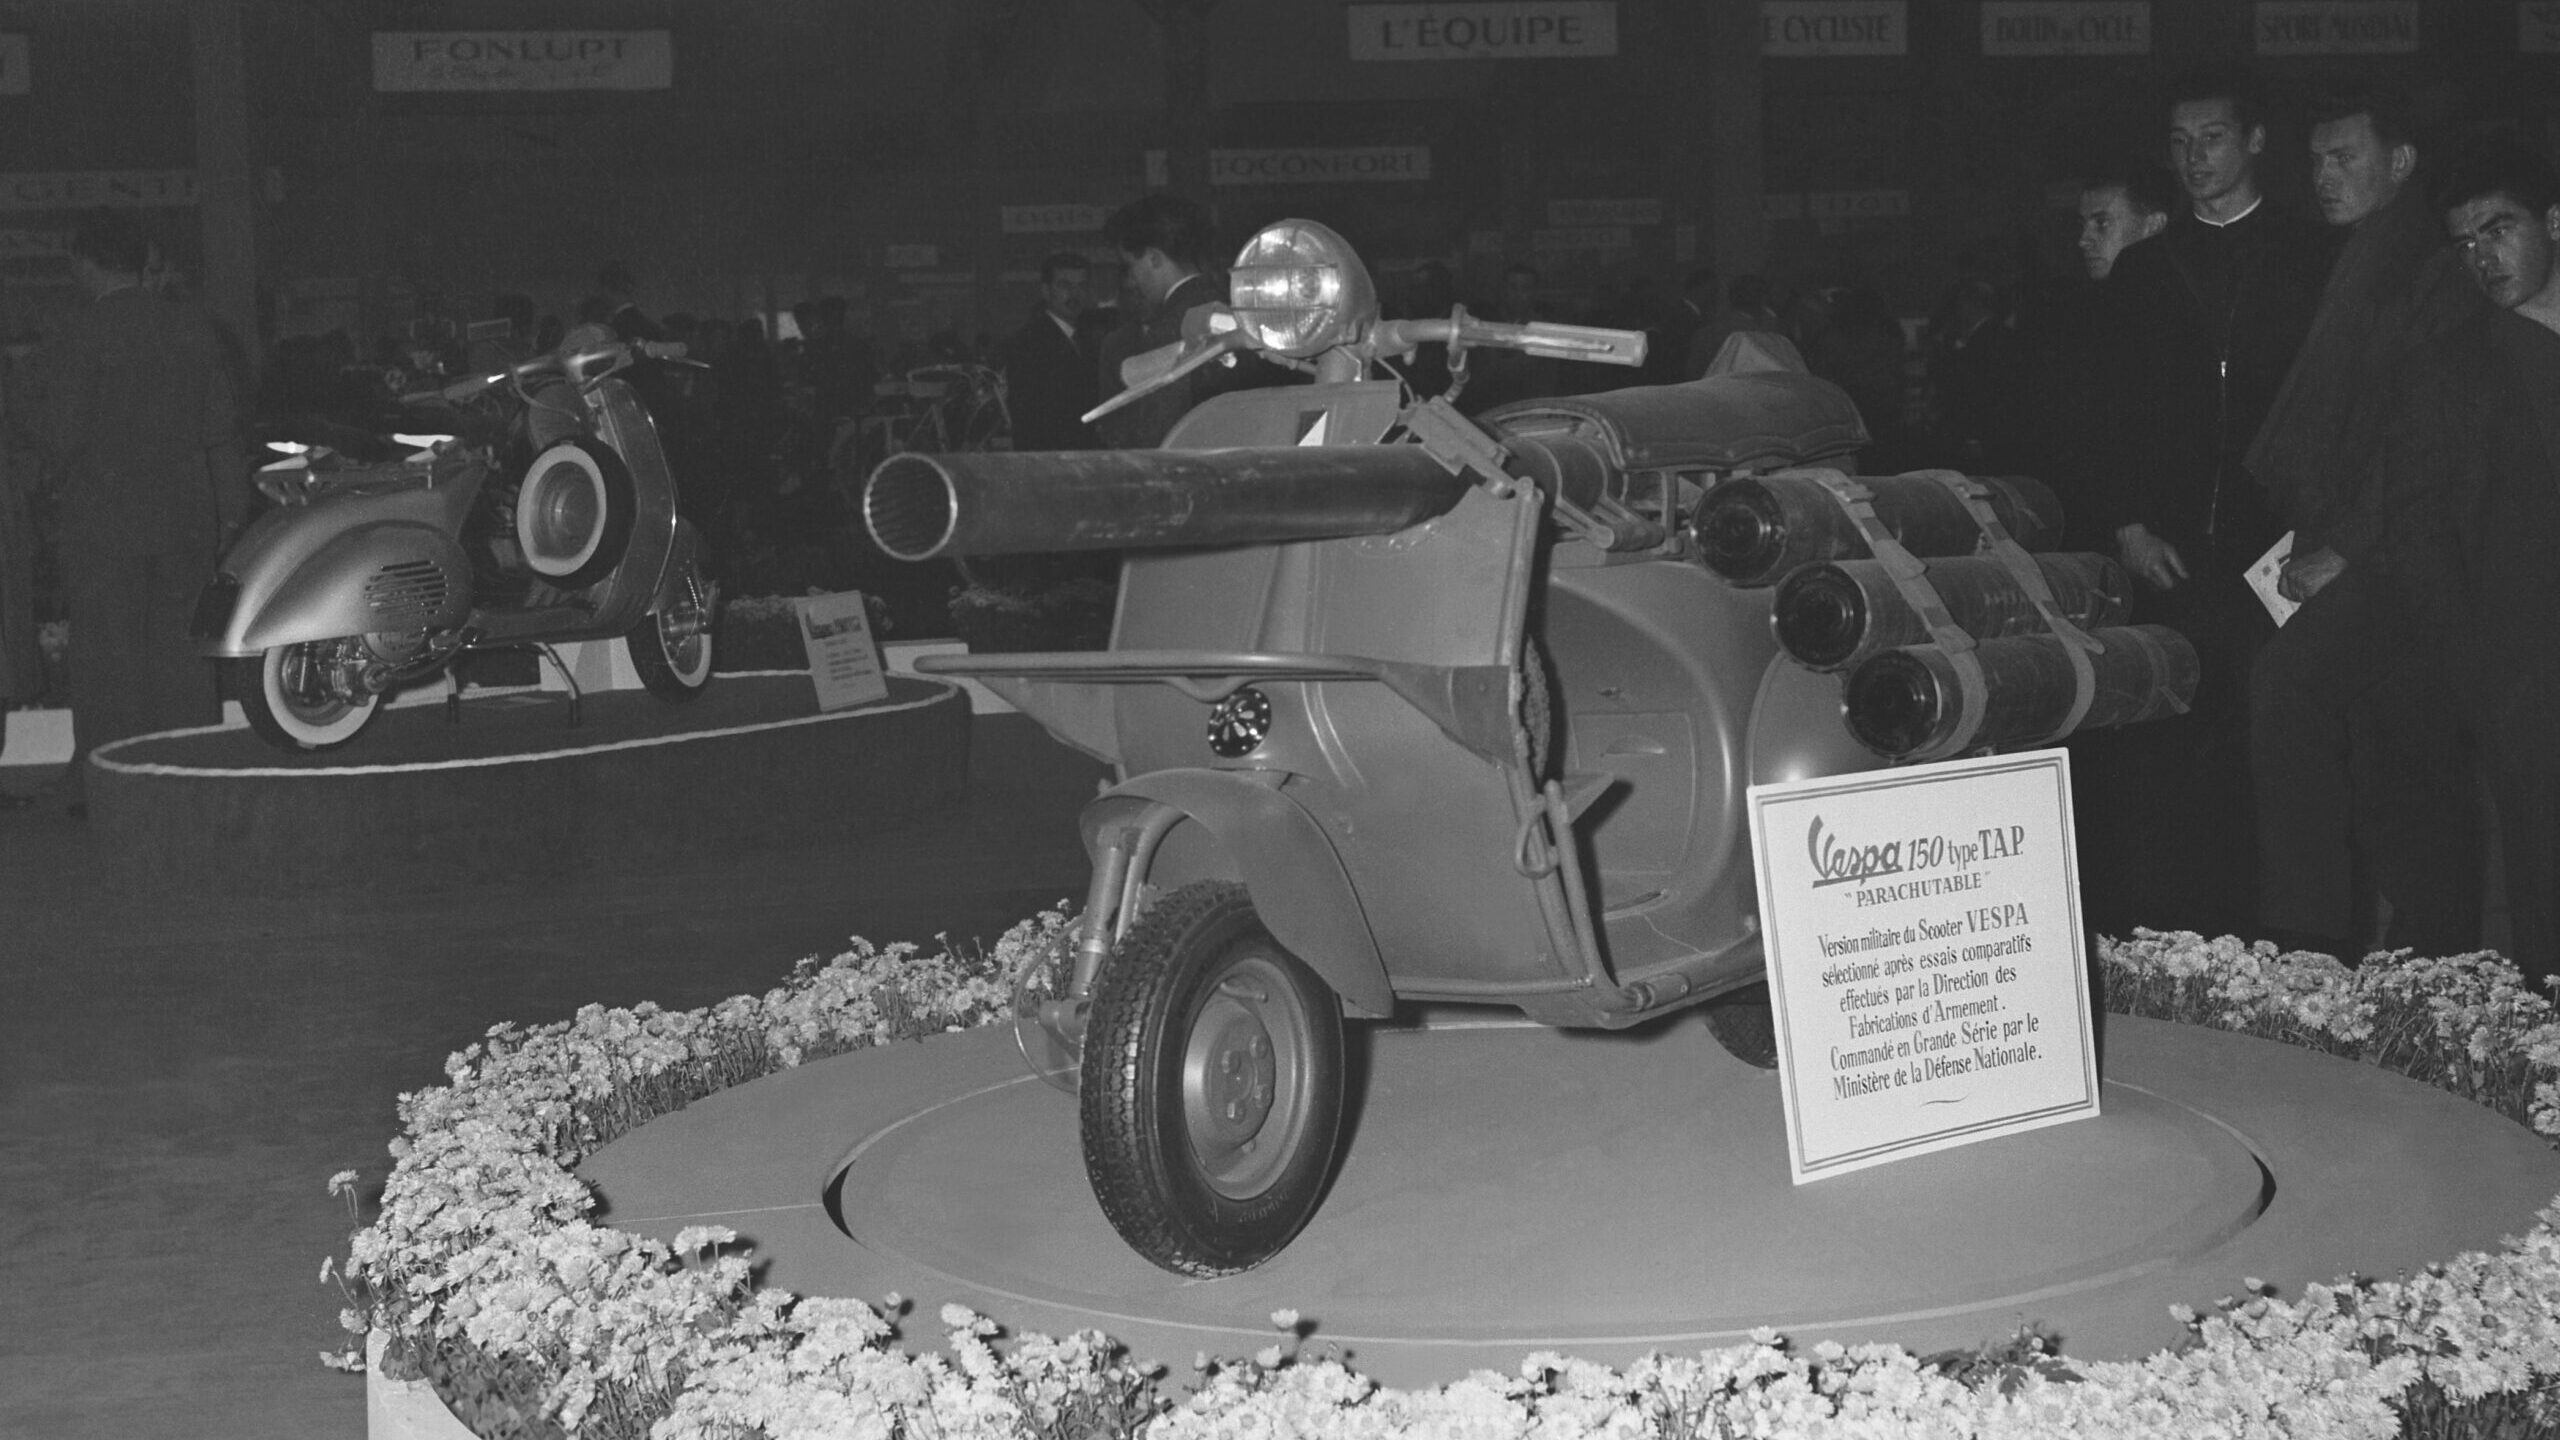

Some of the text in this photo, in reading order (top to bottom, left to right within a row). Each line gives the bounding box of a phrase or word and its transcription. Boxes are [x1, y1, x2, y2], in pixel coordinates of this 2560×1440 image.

[414, 38, 628, 61] FONLUPT
[1382, 12, 1584, 50] L'ÉQUIPE
[1784, 13, 1890, 42] CYCLISTE
[1807, 814, 1903, 888] Vespa
[1907, 835, 1943, 872] 150
[1947, 839, 1979, 872] type
[1818, 902, 2029, 959] Version militaire du Scooter VESPA
[1822, 934, 2032, 988] sélectionné après essais comparatifs
[1840, 964, 2017, 1012] effectués par la Direction des
[1830, 1012, 2039, 1071] Commandé en Grande Série par le
[1849, 1009, 1918, 1039] Fabrications
[1833, 1041, 2042, 1100] Ministère de la Défense Nationale.
